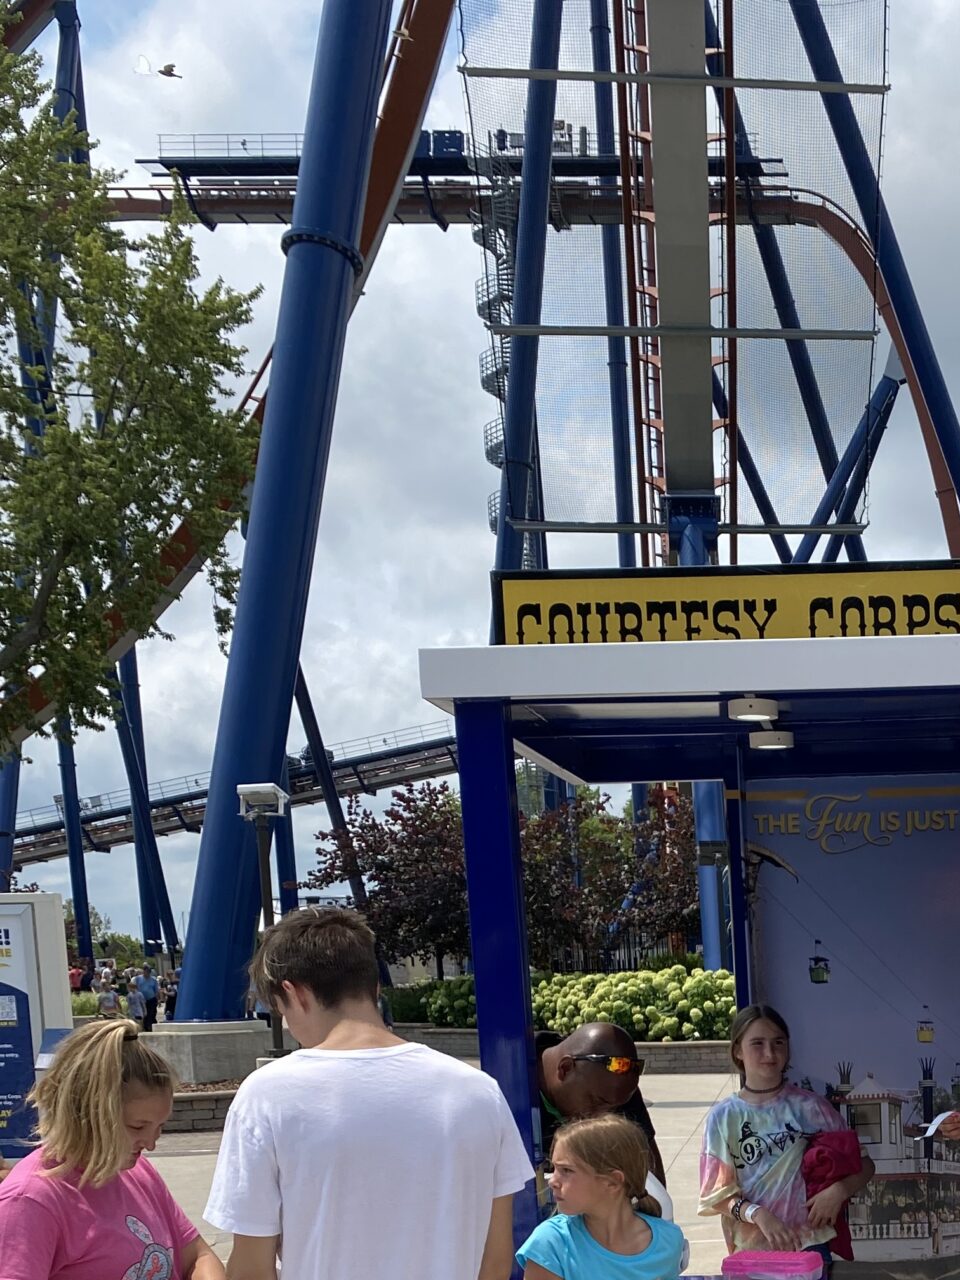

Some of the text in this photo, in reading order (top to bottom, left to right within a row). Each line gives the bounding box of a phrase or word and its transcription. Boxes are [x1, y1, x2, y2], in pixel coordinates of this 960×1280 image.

[516, 599, 778, 644] COURTESY
[754, 813, 800, 834] THE
[804, 794, 892, 855] Fun
[880, 811, 899, 832] IS
[903, 809, 958, 836] JUST
